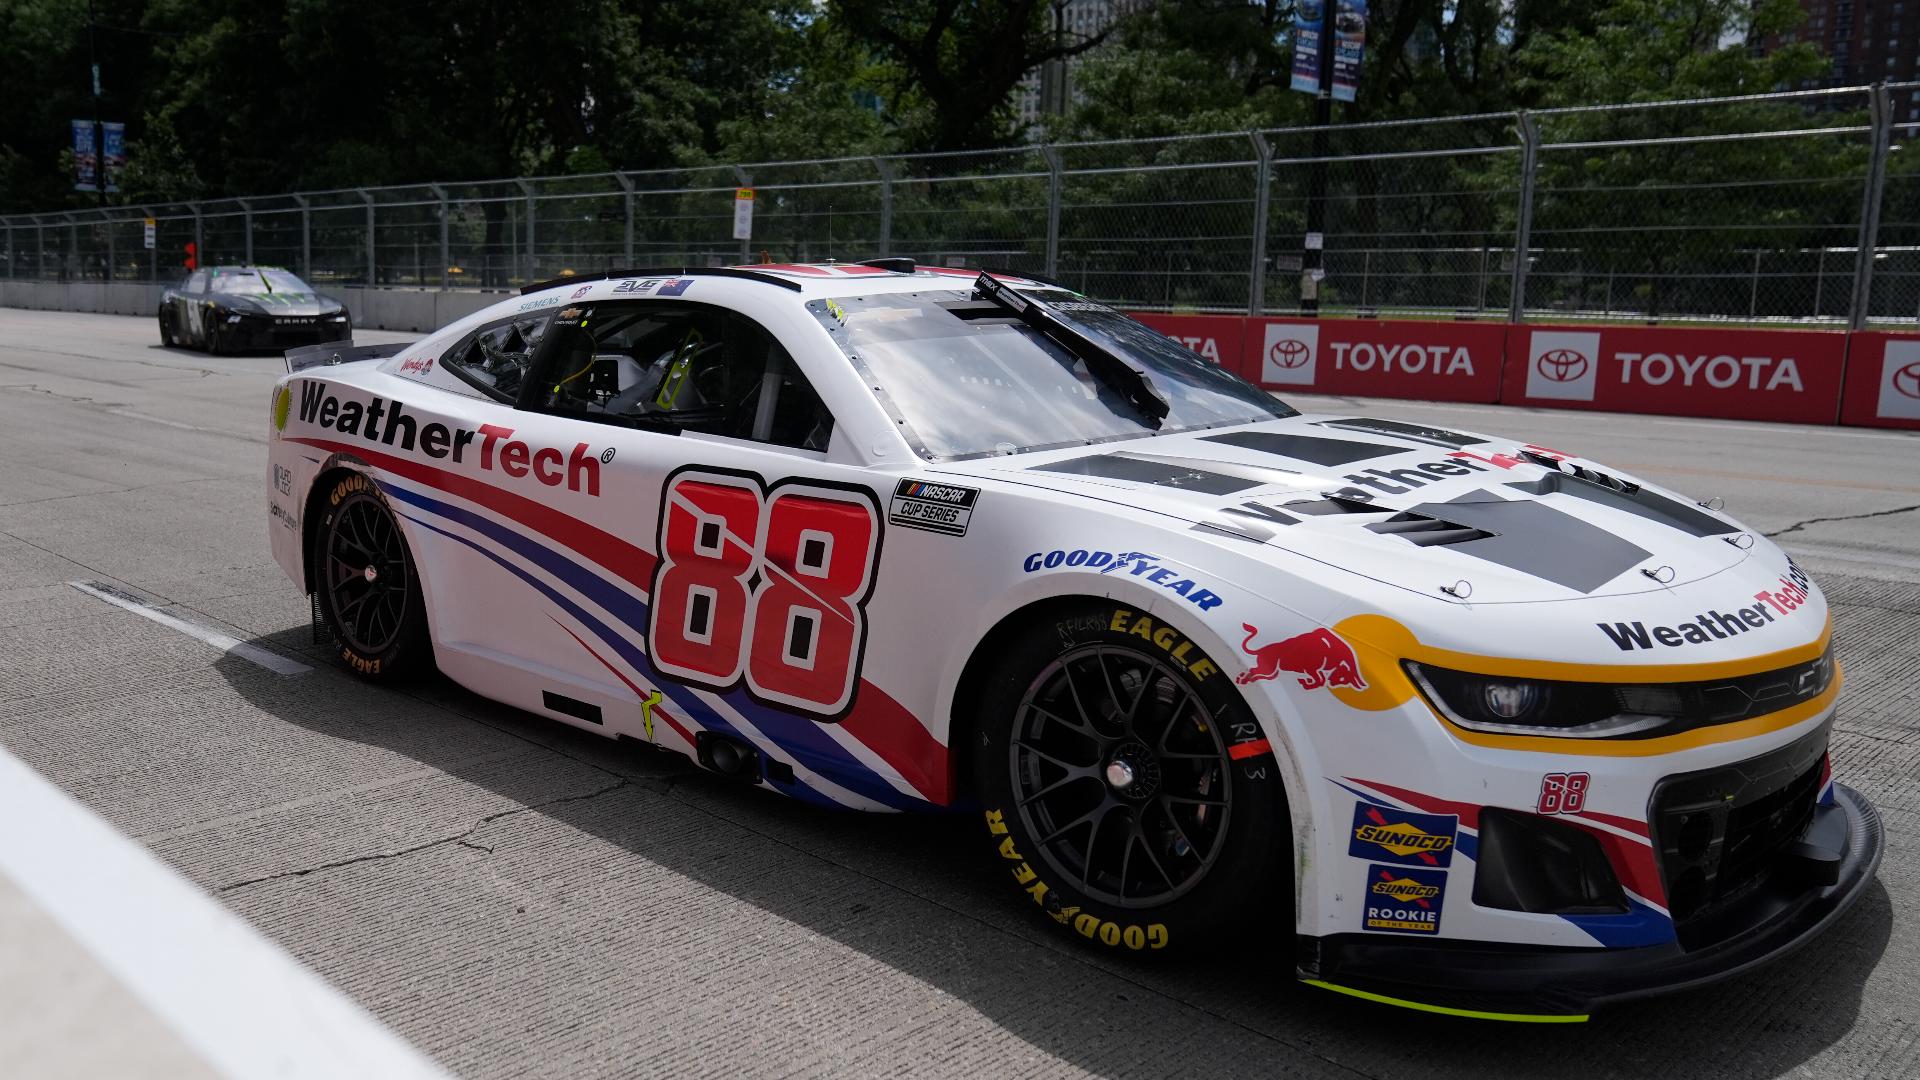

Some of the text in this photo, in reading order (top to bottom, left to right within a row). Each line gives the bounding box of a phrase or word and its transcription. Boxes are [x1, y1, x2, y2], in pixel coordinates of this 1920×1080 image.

[519, 296, 560, 311] SIEMENS
[1330, 342, 1475, 376] TOYOTA
[1615, 352, 1803, 391] TOYOTA
[919, 484, 966, 503] NASCAR
[900, 502, 960, 523] CUP SERIES
[645, 464, 885, 724] 88
[1023, 549, 1224, 612] GOODYEAR
[343, 647, 381, 674] EAGLE
[1110, 609, 1218, 682] EAGLE
[1537, 772, 1591, 814] 88
[1357, 826, 1452, 851] SUNOCO
[985, 808, 1169, 950] GOODYEAR
[1375, 883, 1438, 897] SUNOCO
[1368, 907, 1437, 922] ROOKIE
